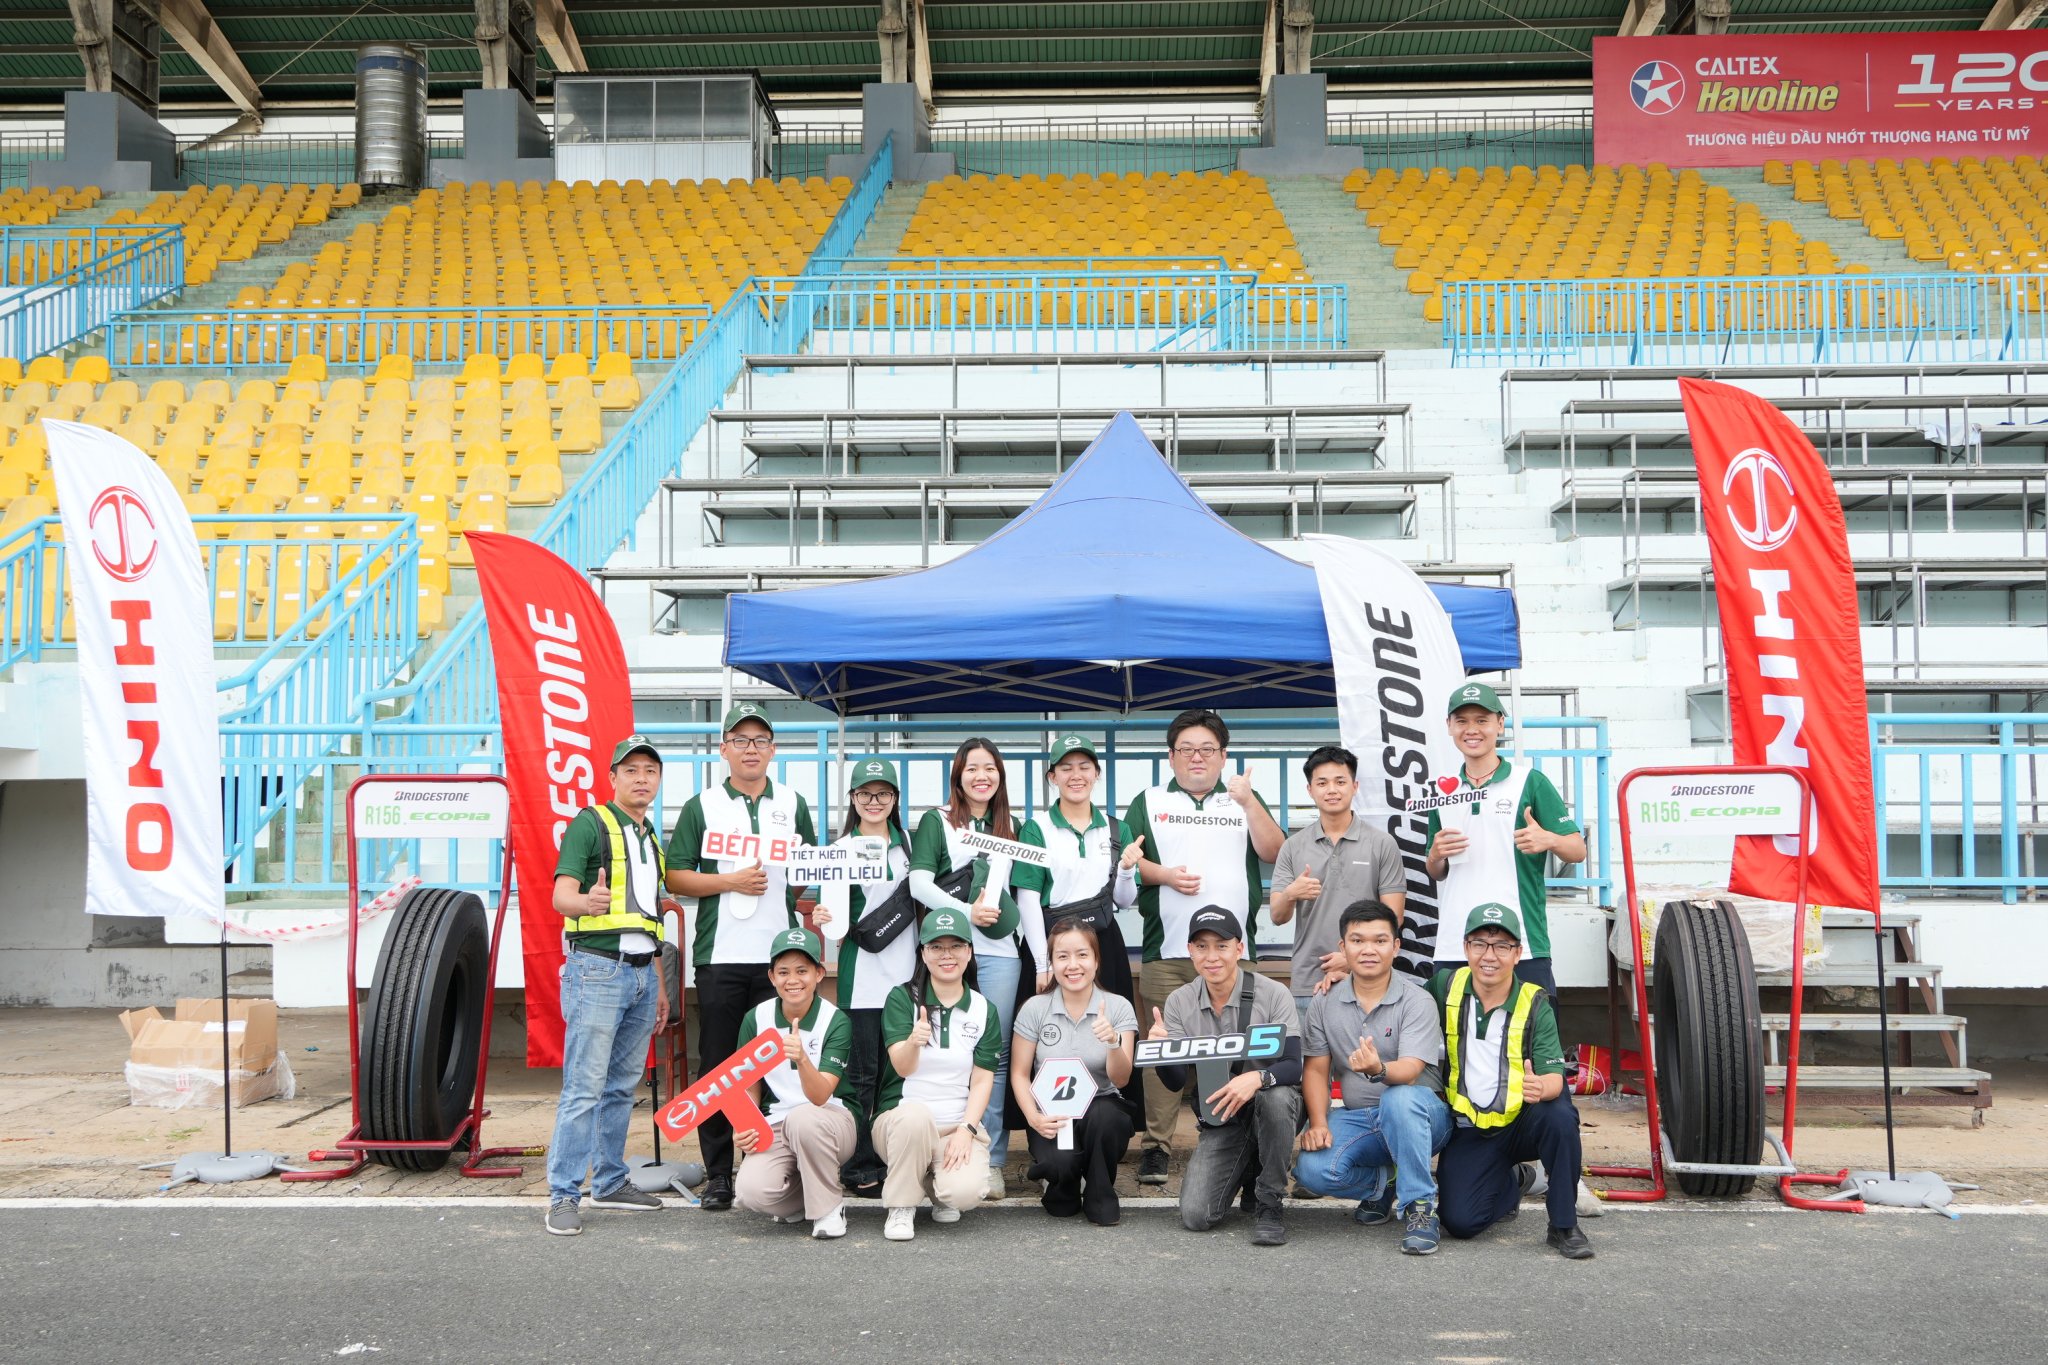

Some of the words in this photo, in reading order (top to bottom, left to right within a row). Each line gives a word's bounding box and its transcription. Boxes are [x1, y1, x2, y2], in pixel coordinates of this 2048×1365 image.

[1695, 57, 1779, 76] CALTEX
[1696, 80, 1839, 113] Havoline
[1937, 97, 2034, 111] YEARS
[1686, 131, 1747, 146] THƯƠNG
[1752, 131, 1786, 147] HIỆU
[1791, 128, 1822, 145] DẦU
[1826, 128, 1866, 144] NHỚT
[1870, 129, 1932, 145] THƯỢNG
[1936, 130, 1978, 144] HẠNG
[1982, 126, 2003, 142] TỪ
[2006, 125, 2031, 141] MỸ
[110, 600, 174, 872] HINO
[394, 790, 470, 802] BRIDGESTONE
[1427, 780, 1439, 797] I
[1670, 784, 1756, 797] BRIDGESTONE
[1407, 789, 1488, 812] BRIDGESTONE
[365, 805, 401, 826] R156
[410, 812, 491, 821] ECOPIA
[1168, 815, 1243, 827] BRIDGESTONE
[1640, 801, 1681, 824] R156
[1690, 806, 1782, 818] ECOPIA
[791, 848, 815, 861] TIẾT
[960, 832, 1047, 863] BRIDGESTONE
[795, 864, 843, 882] NHIÊN
[849, 863, 883, 882] LIỆU
[883, 912, 902, 931] HINO
[696, 1039, 779, 1107] HINO
